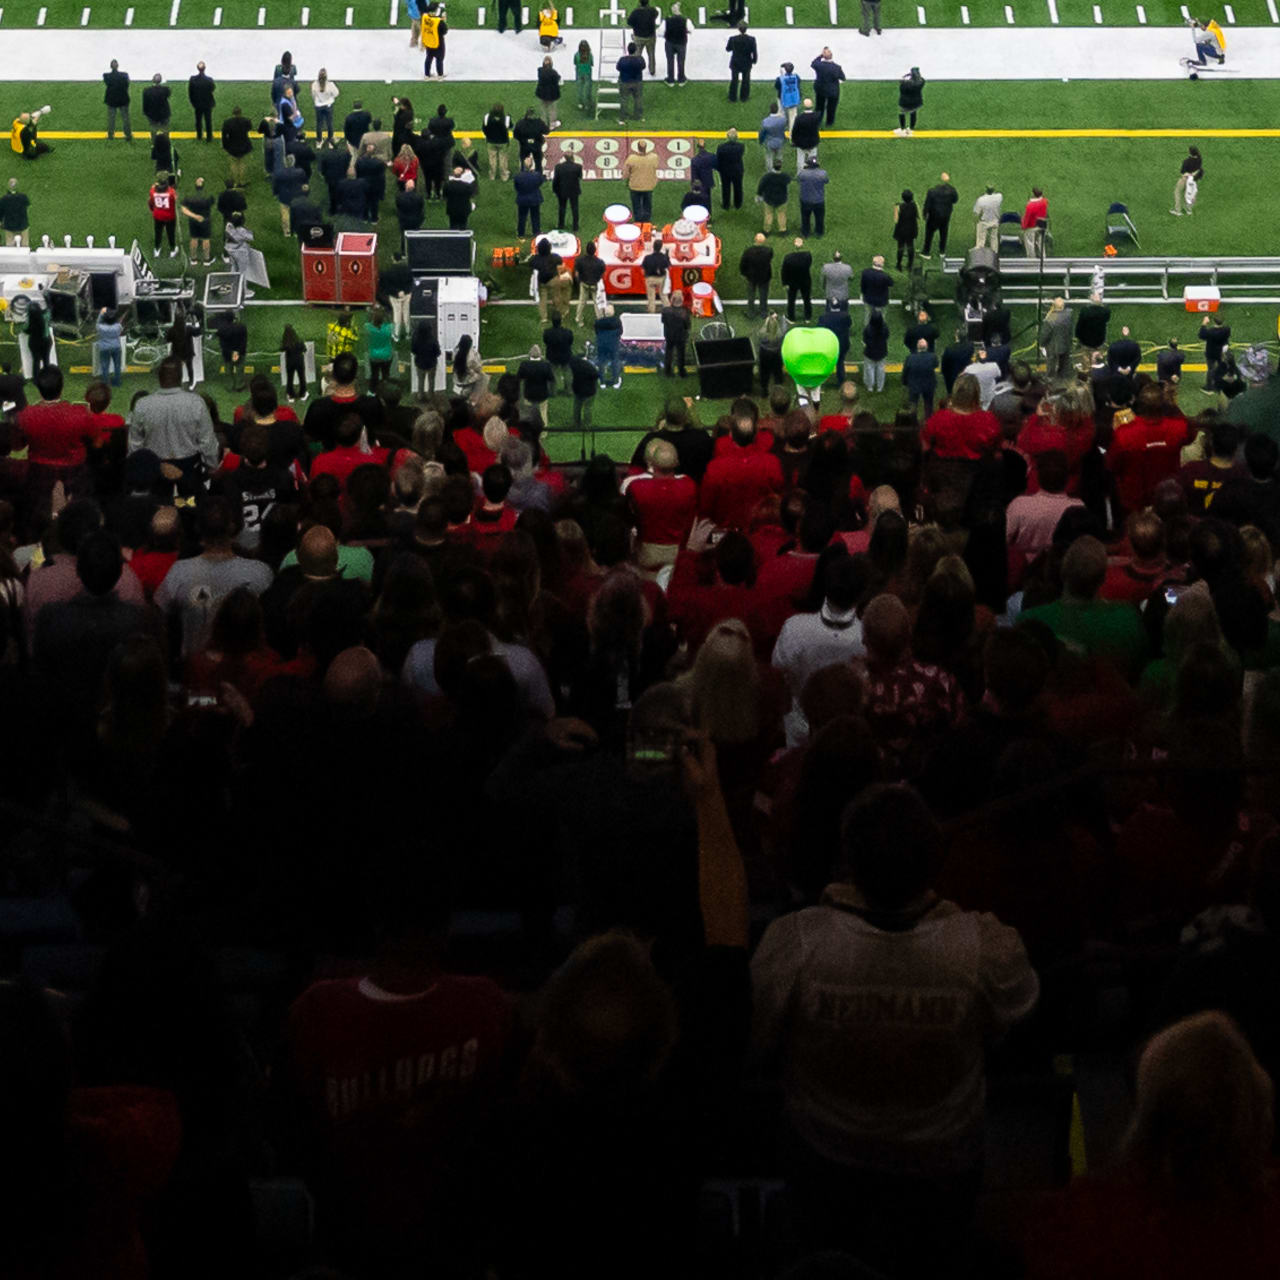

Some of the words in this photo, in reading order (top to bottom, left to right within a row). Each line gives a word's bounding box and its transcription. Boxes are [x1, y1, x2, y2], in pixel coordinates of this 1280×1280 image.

[154, 197, 170, 209] 84
[610, 268, 632, 290] G
[1197, 300, 1208, 311] G
